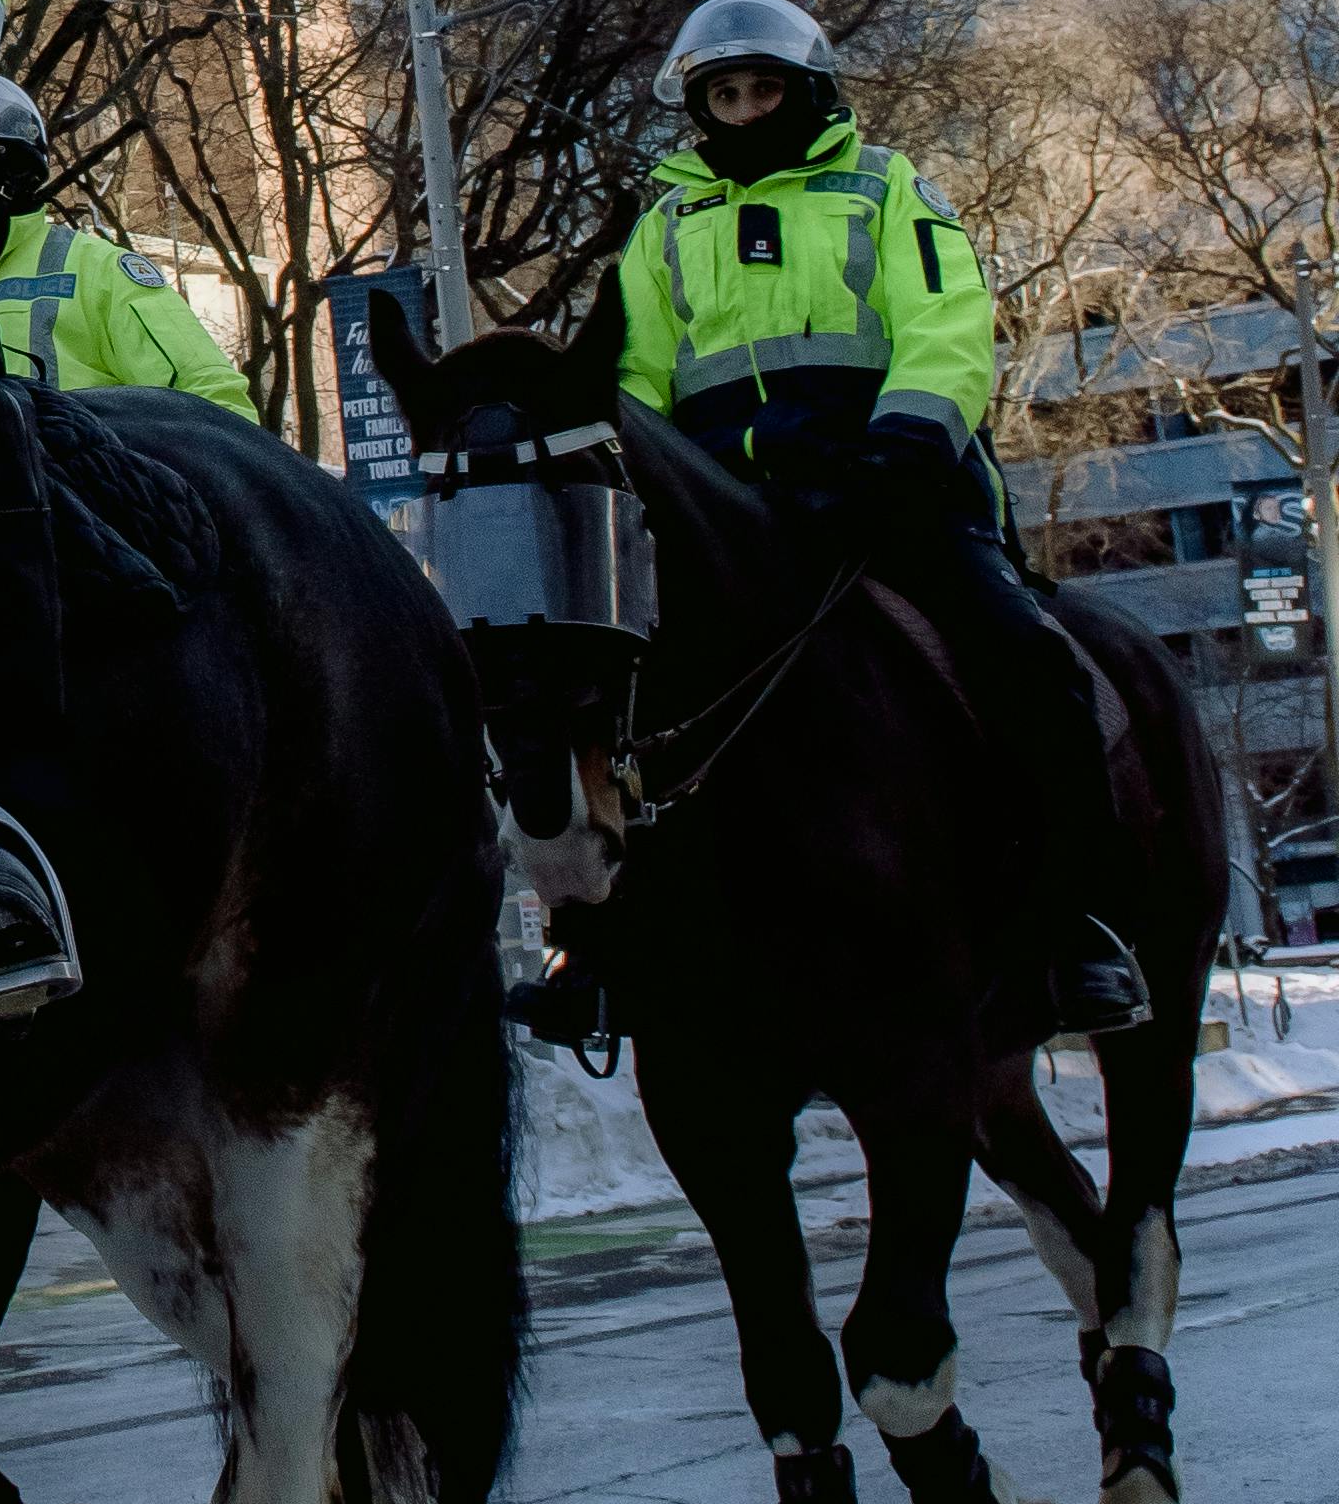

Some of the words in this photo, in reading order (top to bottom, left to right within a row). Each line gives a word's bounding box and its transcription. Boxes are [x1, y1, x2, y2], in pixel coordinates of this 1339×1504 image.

[343, 397, 379, 419] PETER
[348, 438, 394, 460] PATIENT
[396, 436, 412, 455] CA
[368, 459, 411, 480] TOWER
